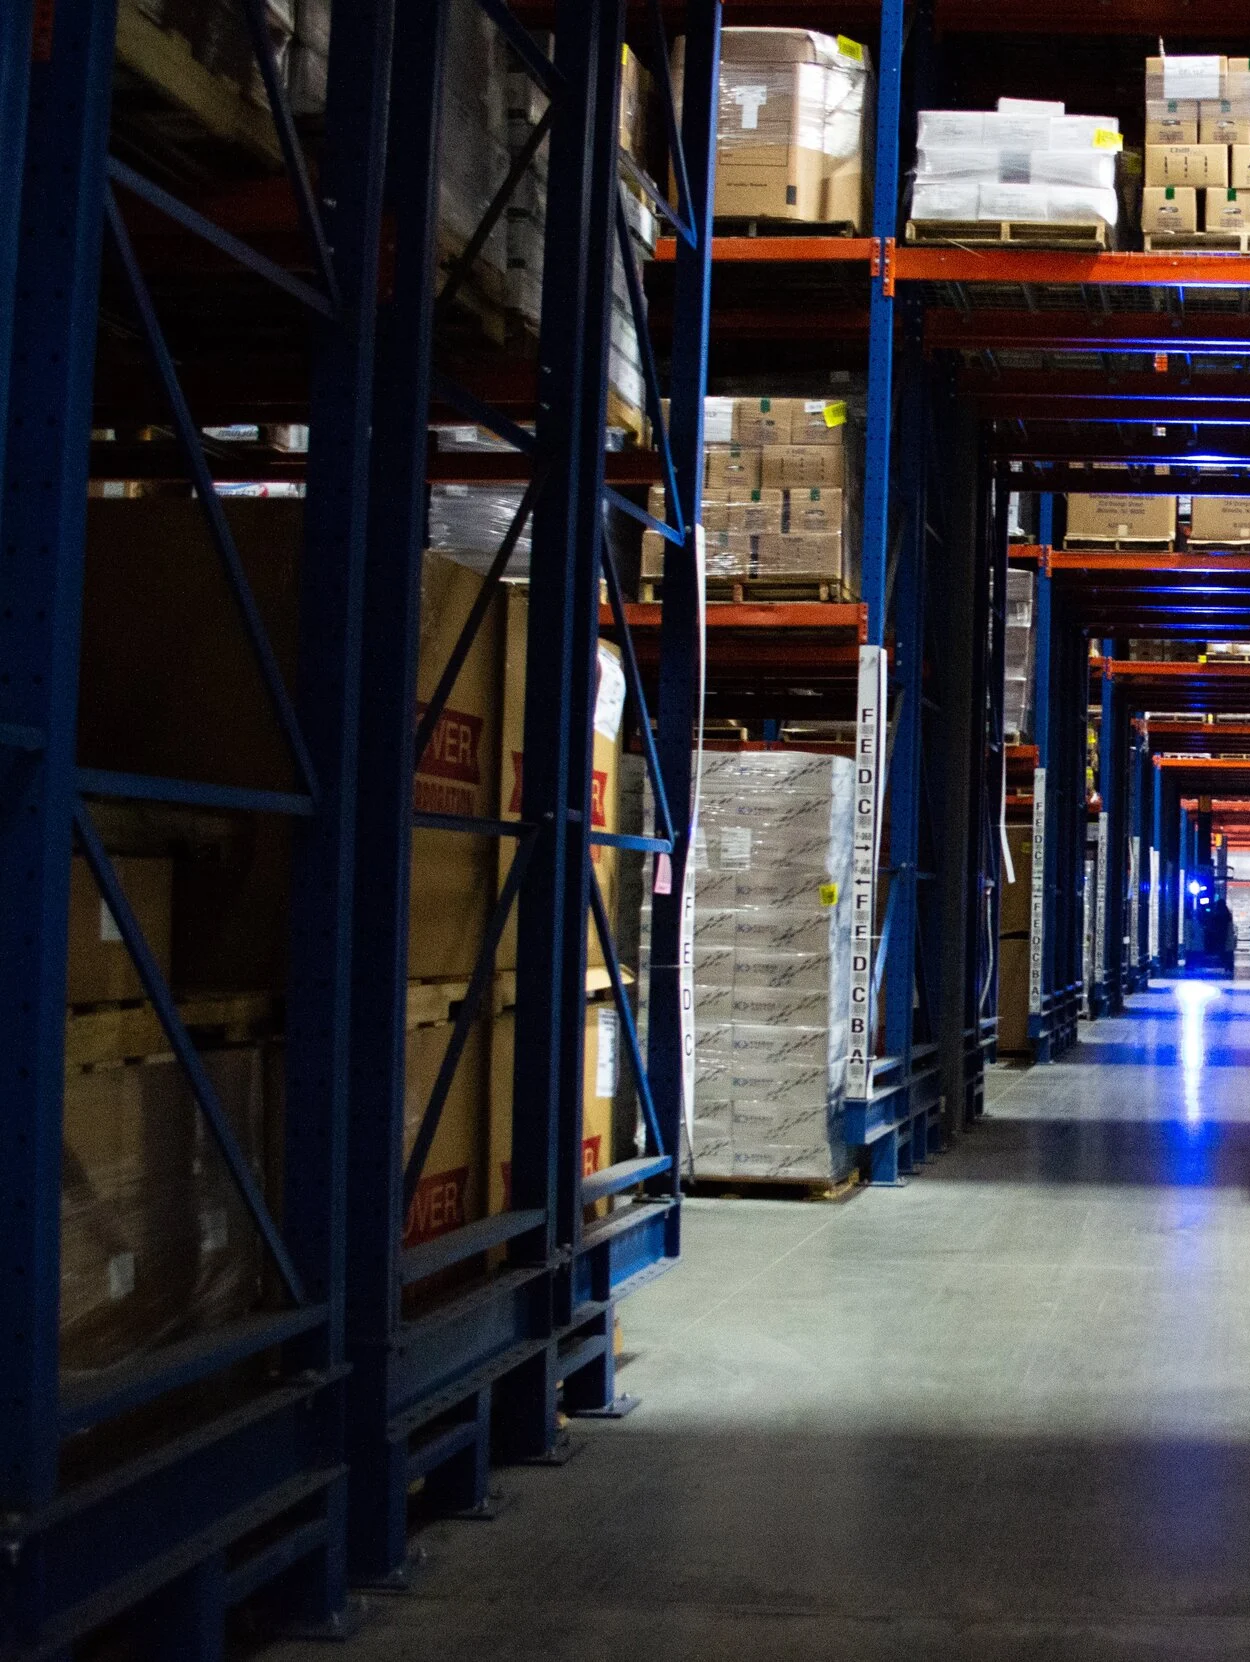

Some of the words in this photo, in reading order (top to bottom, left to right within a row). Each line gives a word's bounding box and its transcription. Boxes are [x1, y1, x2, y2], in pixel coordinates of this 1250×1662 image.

[862, 708, 874, 723] F
[860, 738, 872, 754] E
[859, 769, 872, 784] D
[858, 798, 871, 814] C
[856, 894, 868, 909] F
[855, 925, 867, 941] E
[853, 956, 867, 971] D
[853, 987, 865, 1002] C
[852, 1018, 864, 1033] B
[850, 1049, 863, 1064] A
